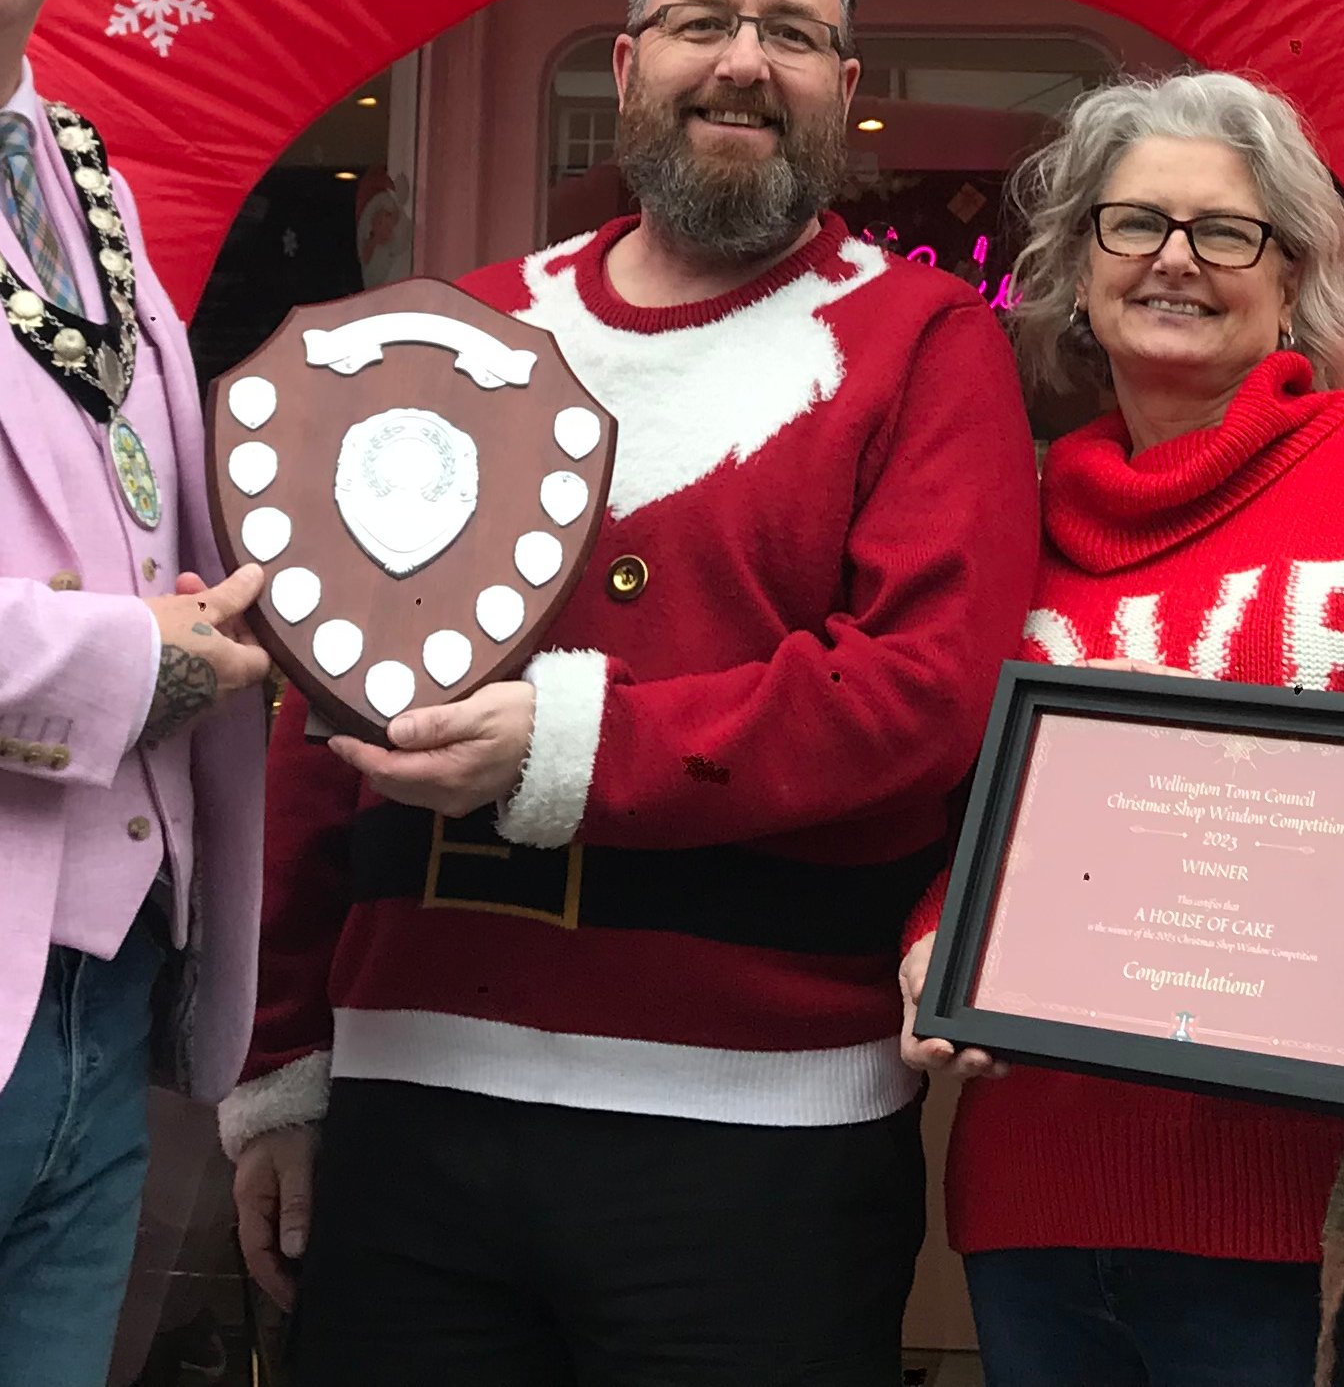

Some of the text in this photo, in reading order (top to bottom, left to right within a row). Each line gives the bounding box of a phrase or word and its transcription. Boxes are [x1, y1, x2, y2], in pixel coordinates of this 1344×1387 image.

[1148, 774, 1316, 808] Wellington Town Council
[1106, 791, 1171, 815] Christmas
[1173, 799, 1206, 824] Shop
[1209, 805, 1268, 826] Window
[1202, 830, 1238, 852] 2023
[1181, 859, 1249, 881] WINNER
[1134, 907, 1275, 940] A HOUSE OF CAKE
[1123, 960, 1265, 997] Congratulations!
